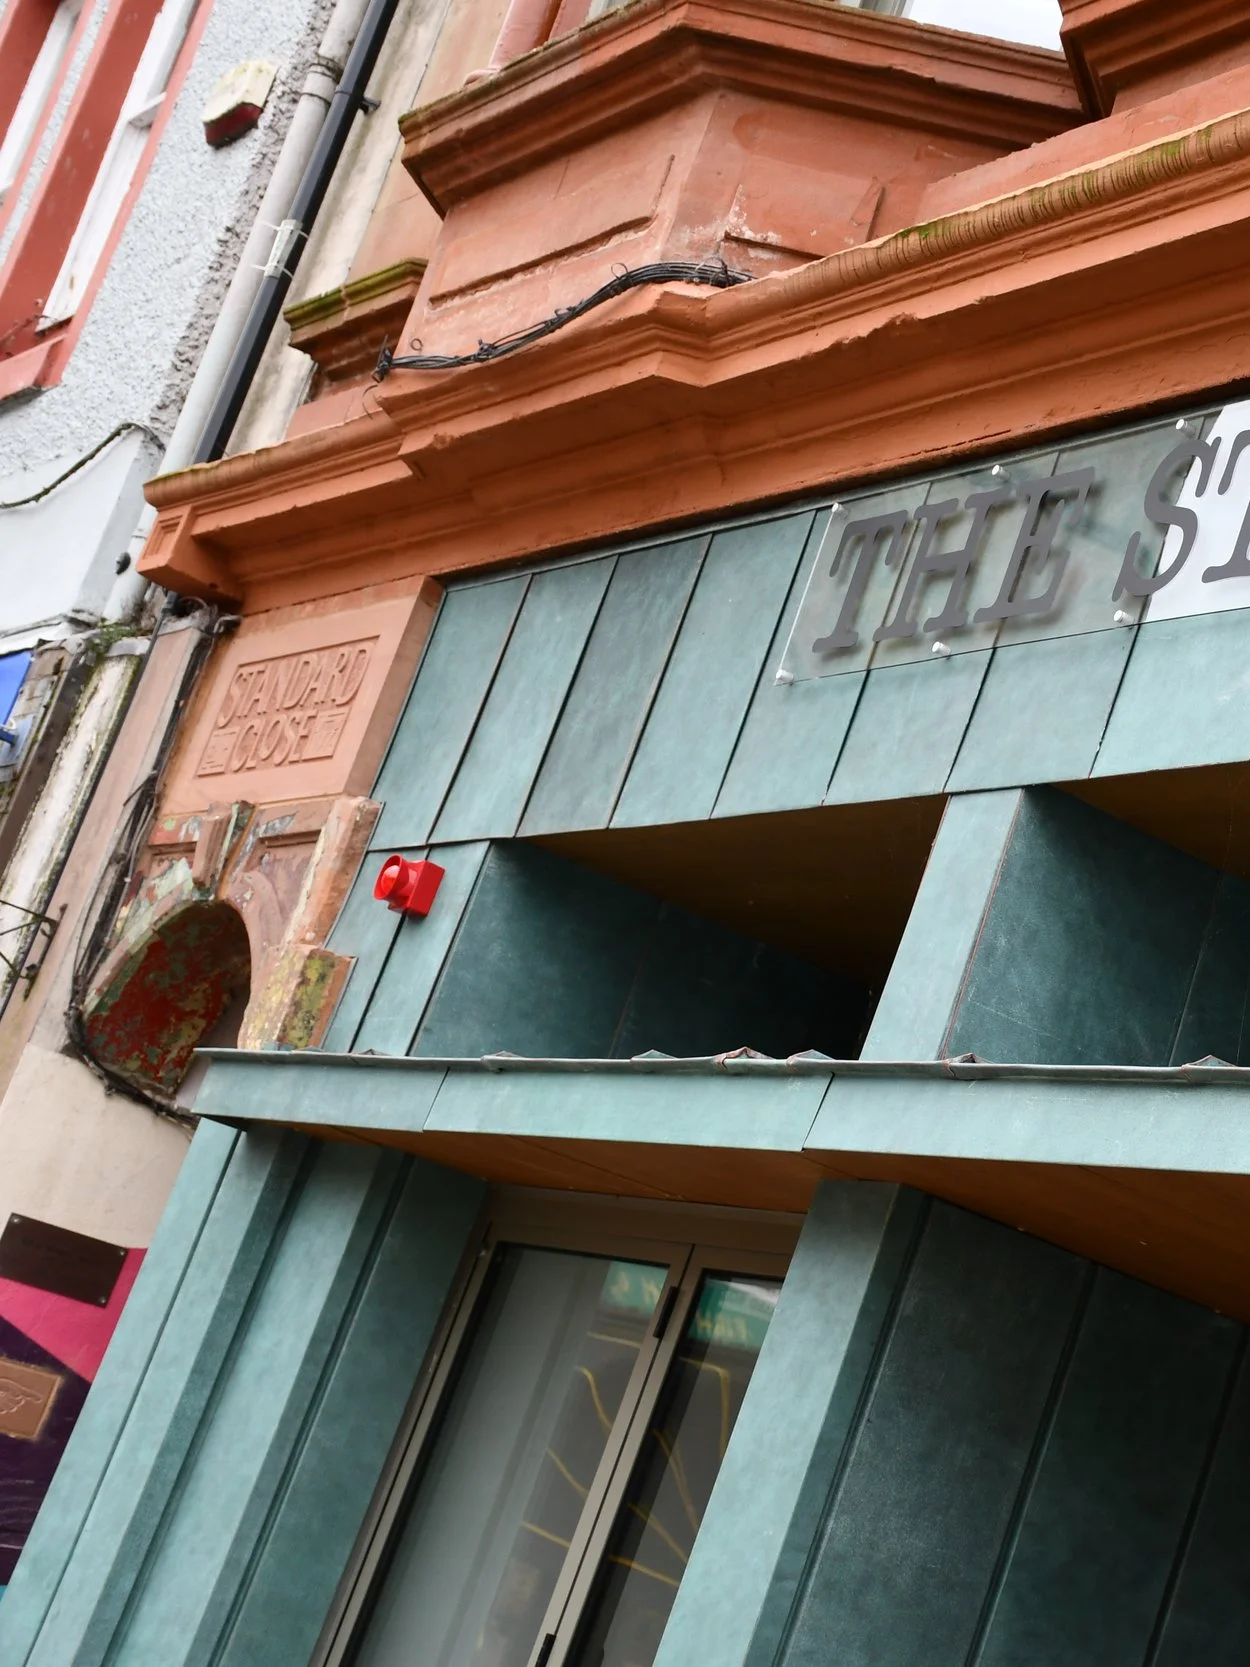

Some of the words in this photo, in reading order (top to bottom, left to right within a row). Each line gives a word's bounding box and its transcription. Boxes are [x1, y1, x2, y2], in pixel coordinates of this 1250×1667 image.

[812, 466, 1095, 654] THE
[215, 641, 376, 729] STANDARD
[231, 708, 319, 773] CLOSE
